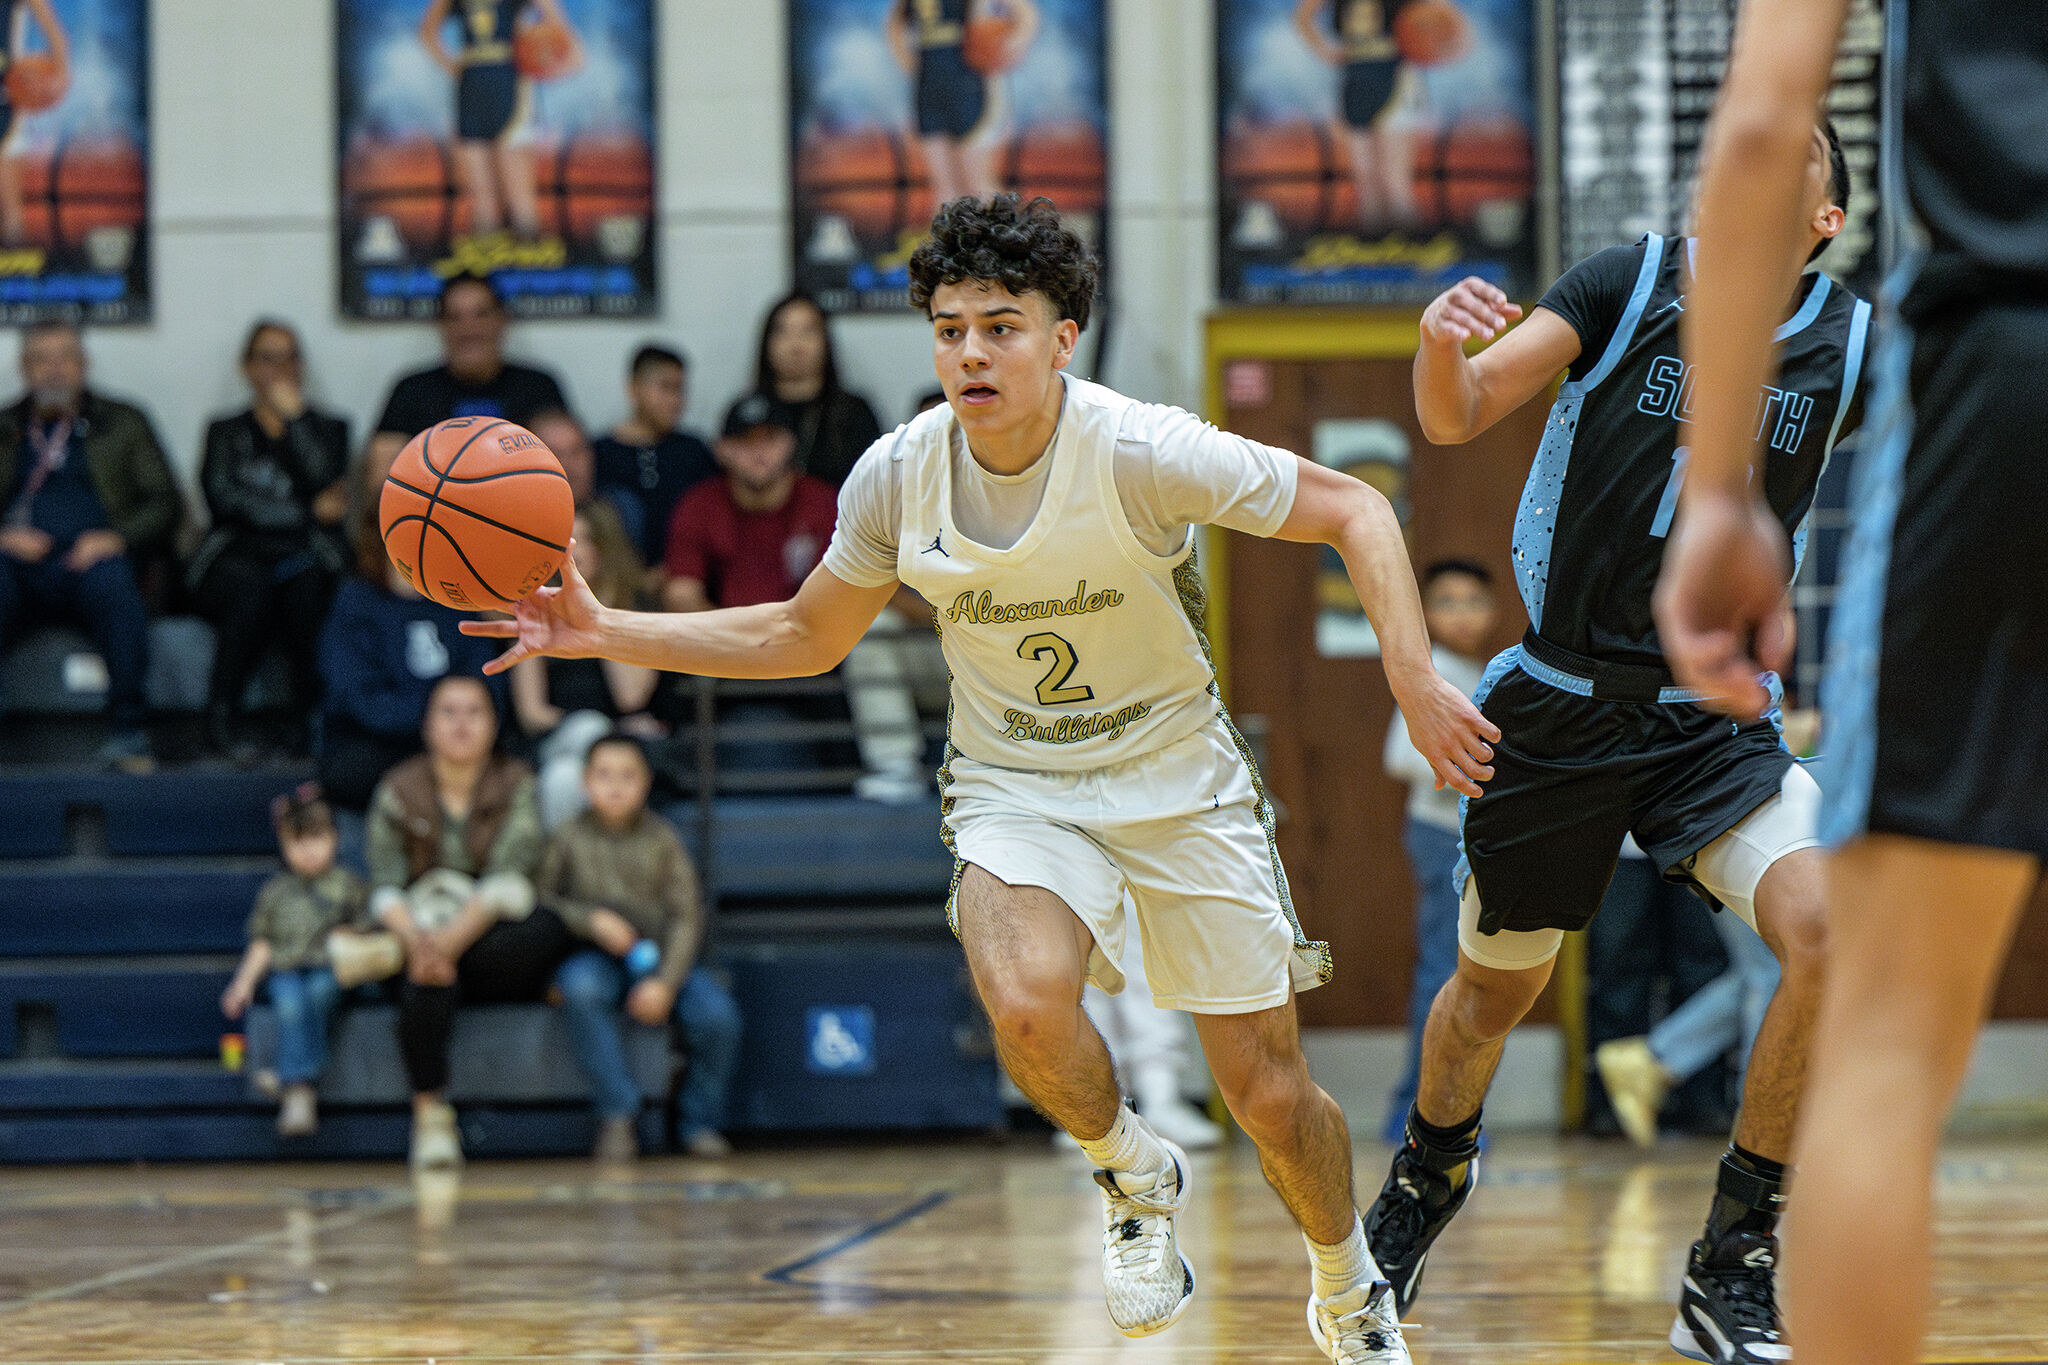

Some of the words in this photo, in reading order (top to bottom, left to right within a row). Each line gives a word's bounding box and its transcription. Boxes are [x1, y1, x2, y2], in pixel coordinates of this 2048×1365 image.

[1636, 355, 1815, 455] SOTH
[945, 580, 1124, 624] Alexander
[1016, 632, 1095, 705] 2
[999, 701, 1152, 744] Bulldogs
